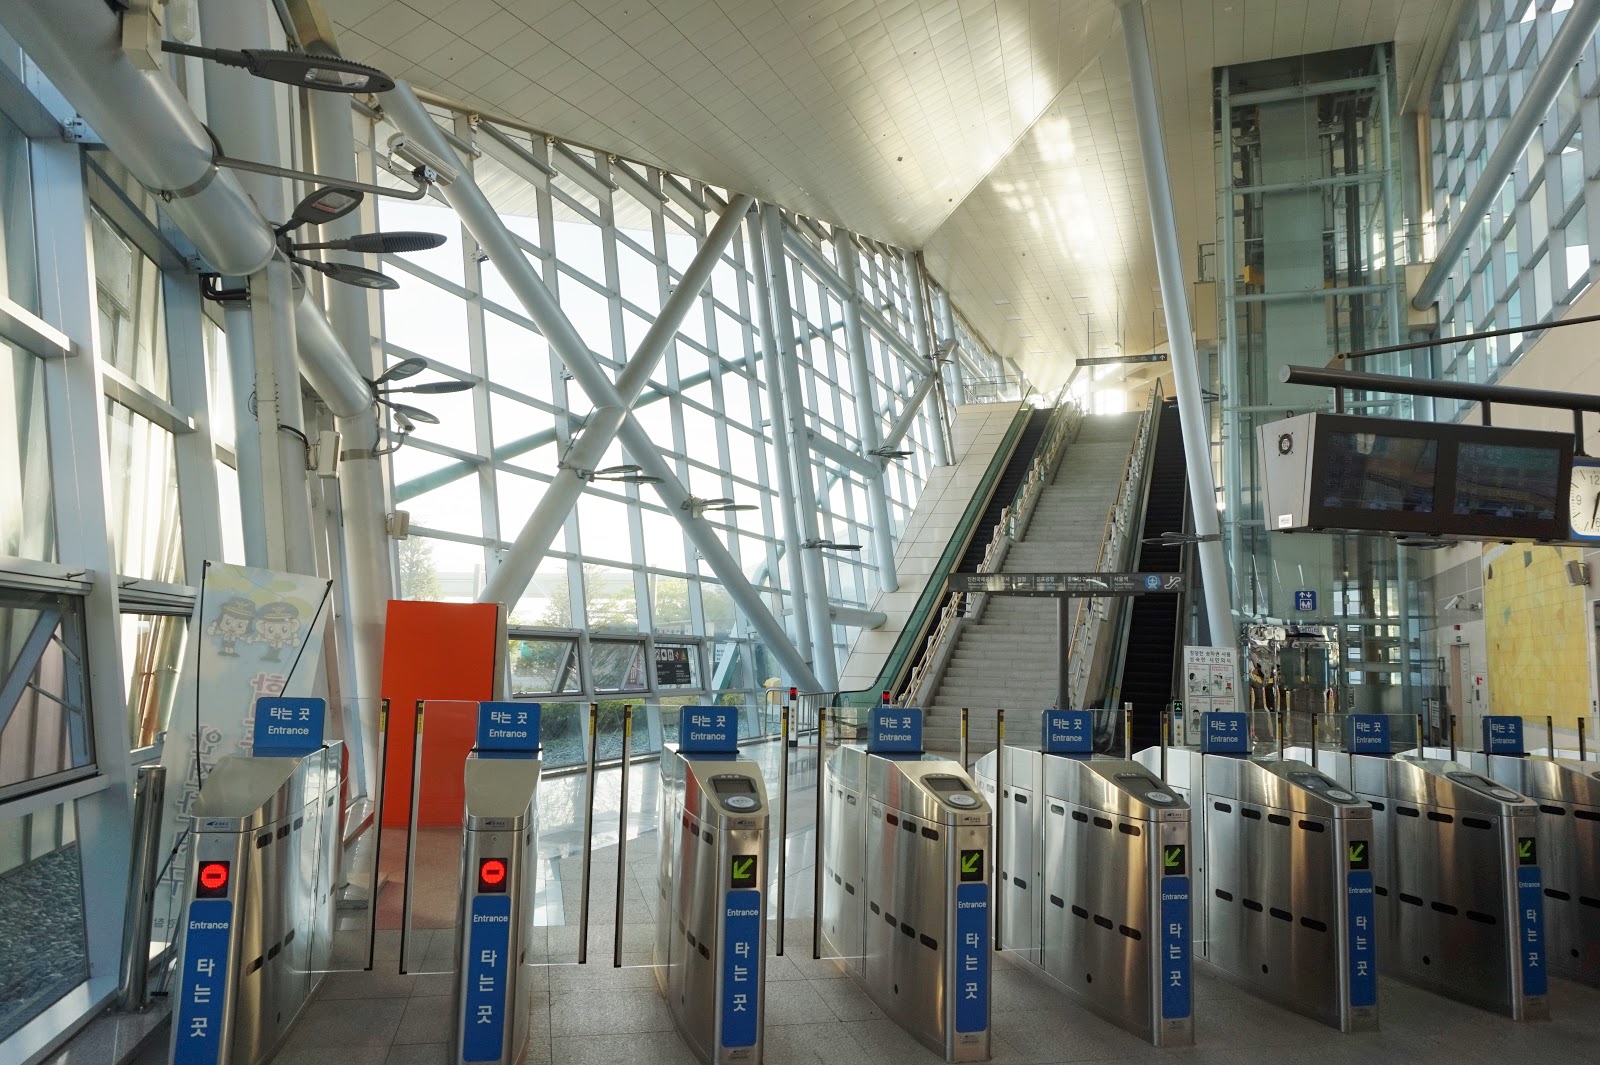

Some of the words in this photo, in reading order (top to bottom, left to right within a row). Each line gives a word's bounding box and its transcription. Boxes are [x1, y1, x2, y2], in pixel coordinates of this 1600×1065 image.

[1589, 475, 1600, 485] 12
[1576, 495, 1581, 505] 9
[270, 707, 293, 720] 타는
[298, 708, 310, 721] 곳
[490, 711, 512, 724] 타는
[517, 712, 528, 725] 곳
[691, 715, 711, 727] 타는
[716, 715, 726, 727] 곳
[880, 717, 898, 729] 타는
[902, 717, 912, 729] 곳
[1053, 718, 1070, 730] 타는
[1073, 718, 1082, 730] 곳
[1211, 720, 1226, 731] 타는
[1230, 720, 1238, 731] 곳
[1356, 722, 1370, 732] 타는
[1374, 722, 1381, 732] 곳
[268, 725, 309, 735] Entrance
[489, 728, 527, 738] Entrance
[1492, 724, 1505, 733] 타는
[1508, 724, 1515, 733] 곳
[690, 732, 726, 740] Entrance
[879, 733, 912, 741] Entrance
[1052, 734, 1082, 742] Entrance
[1210, 735, 1238, 743] Entrance
[958, 901, 986, 909] Entrance
[473, 914, 509, 923] Entrance
[727, 909, 759, 917] Entrance
[189, 921, 229, 929] Entrance
[1526, 909, 1537, 942] 타는
[1356, 916, 1367, 950] 타는
[1170, 923, 1183, 959] 타는
[965, 933, 980, 971] 타는
[734, 942, 750, 982] 타는
[1528, 952, 1538, 967] 곳
[479, 950, 498, 992] 타는
[1357, 961, 1367, 976] 곳
[194, 958, 215, 1003] 타는
[1170, 970, 1181, 986] 곳
[965, 982, 978, 999] 곳
[733, 994, 747, 1012] 곳
[477, 1005, 492, 1024] 곳
[190, 1017, 208, 1037] 곳
